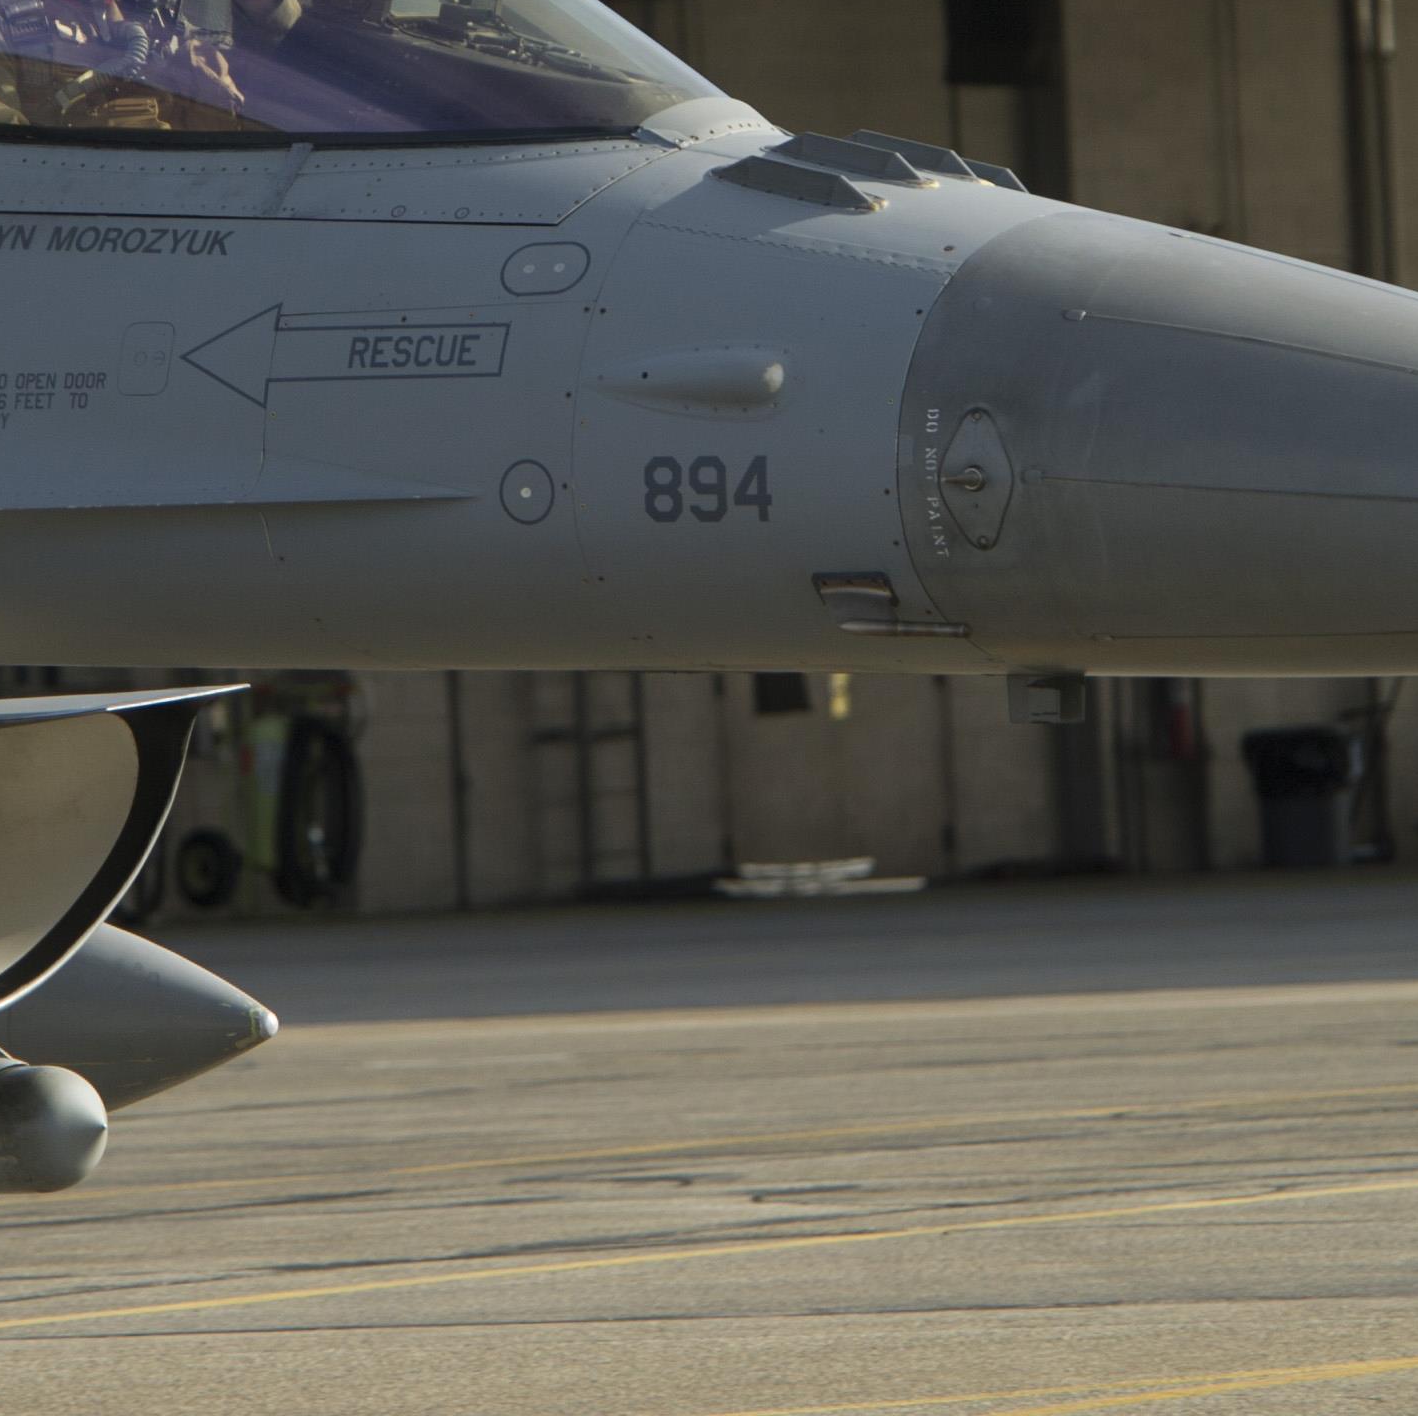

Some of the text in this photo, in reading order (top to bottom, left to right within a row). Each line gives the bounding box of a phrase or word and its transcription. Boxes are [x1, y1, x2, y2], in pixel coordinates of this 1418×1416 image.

[45, 225, 235, 256] MOROZYUK
[347, 334, 481, 369] RESCUE
[16, 372, 58, 390] OPEN
[64, 372, 107, 390] DOOR
[14, 392, 55, 410] FEET
[69, 392, 90, 409] TO
[643, 455, 773, 523] 894
[924, 408, 950, 558] DO NOT PAINT
